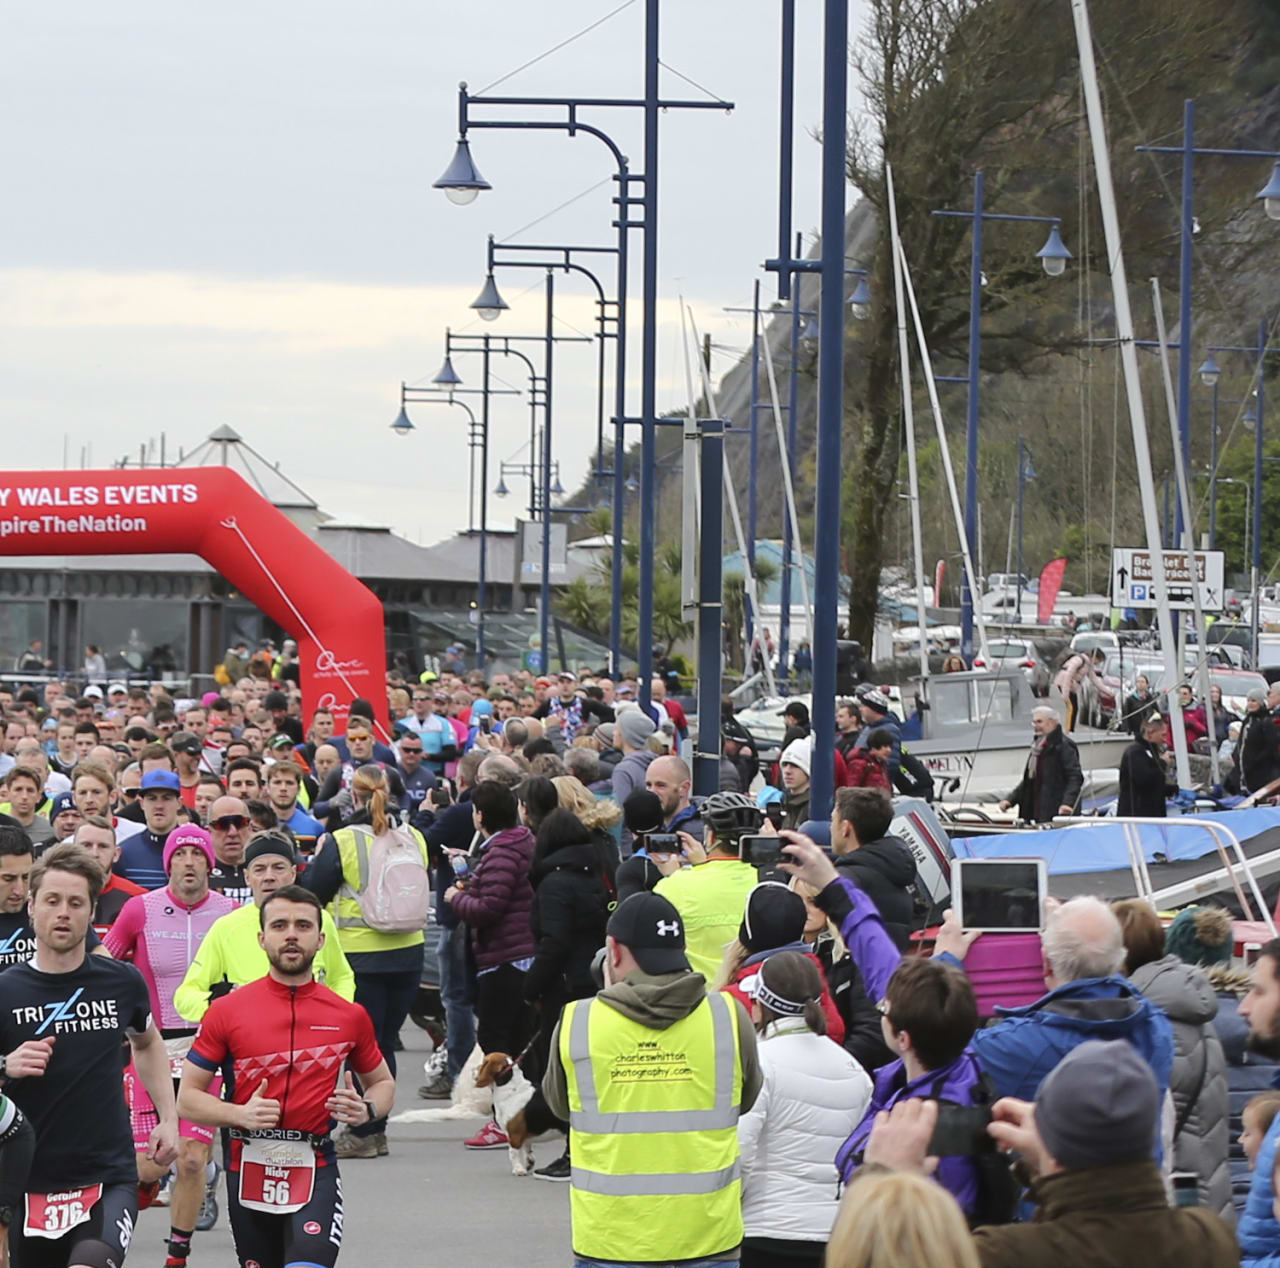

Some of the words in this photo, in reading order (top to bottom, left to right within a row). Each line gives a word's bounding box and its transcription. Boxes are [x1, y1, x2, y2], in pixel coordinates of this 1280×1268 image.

[18, 485, 100, 507] WALES
[104, 484, 198, 505] EVENTS
[898, 826, 928, 864] YAMAHA
[55, 1016, 119, 1034] FITNESS
[615, 1052, 686, 1063] charleswhitton
[249, 1129, 302, 1141] SUNDRIED
[262, 1179, 290, 1205] 56
[44, 1201, 83, 1231] 376
